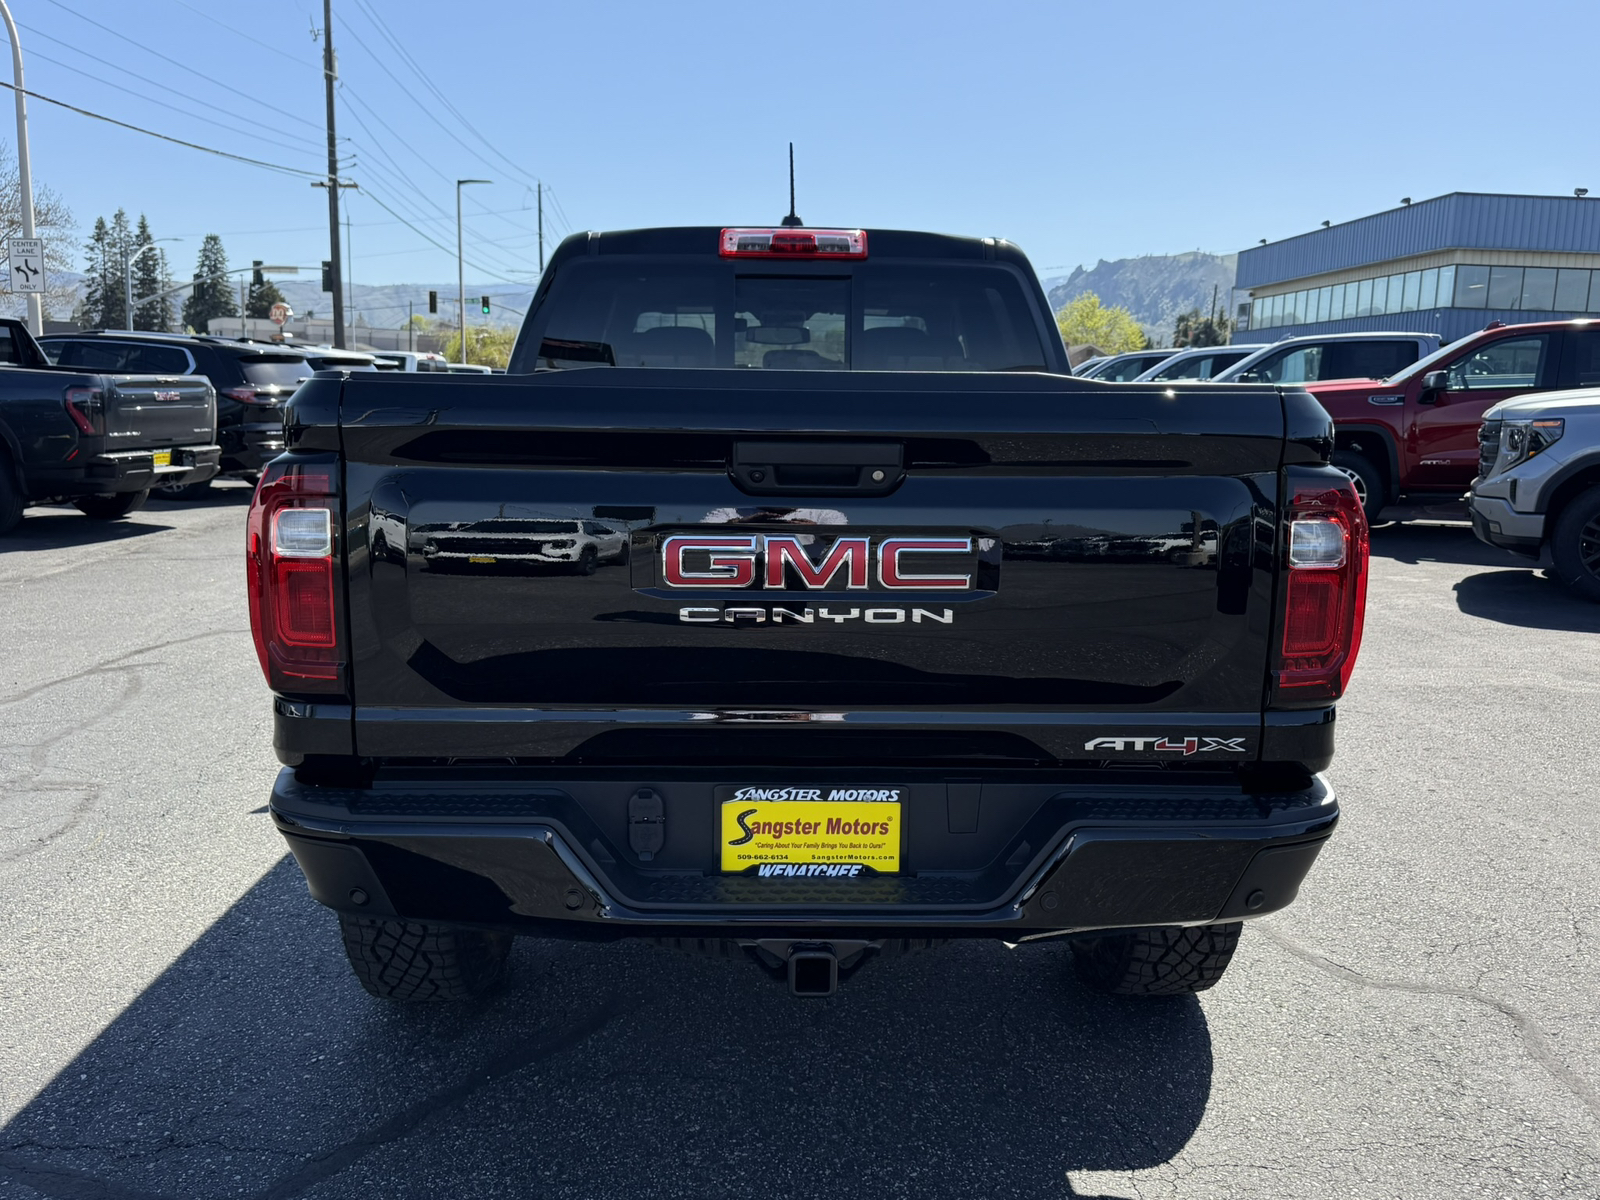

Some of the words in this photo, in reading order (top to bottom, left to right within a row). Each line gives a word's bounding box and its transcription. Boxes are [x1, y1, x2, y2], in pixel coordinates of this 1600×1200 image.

[661, 535, 972, 590] GMC
[679, 607, 953, 624] CANYON
[1084, 737, 1246, 756] AT4X
[722, 786, 823, 803] SANGSTER
[827, 789, 900, 802] MOTORS
[728, 808, 821, 846] Sangster
[803, 842, 820, 850] Family
[821, 842, 837, 850] Brings
[758, 864, 863, 878] WENATCHEE
